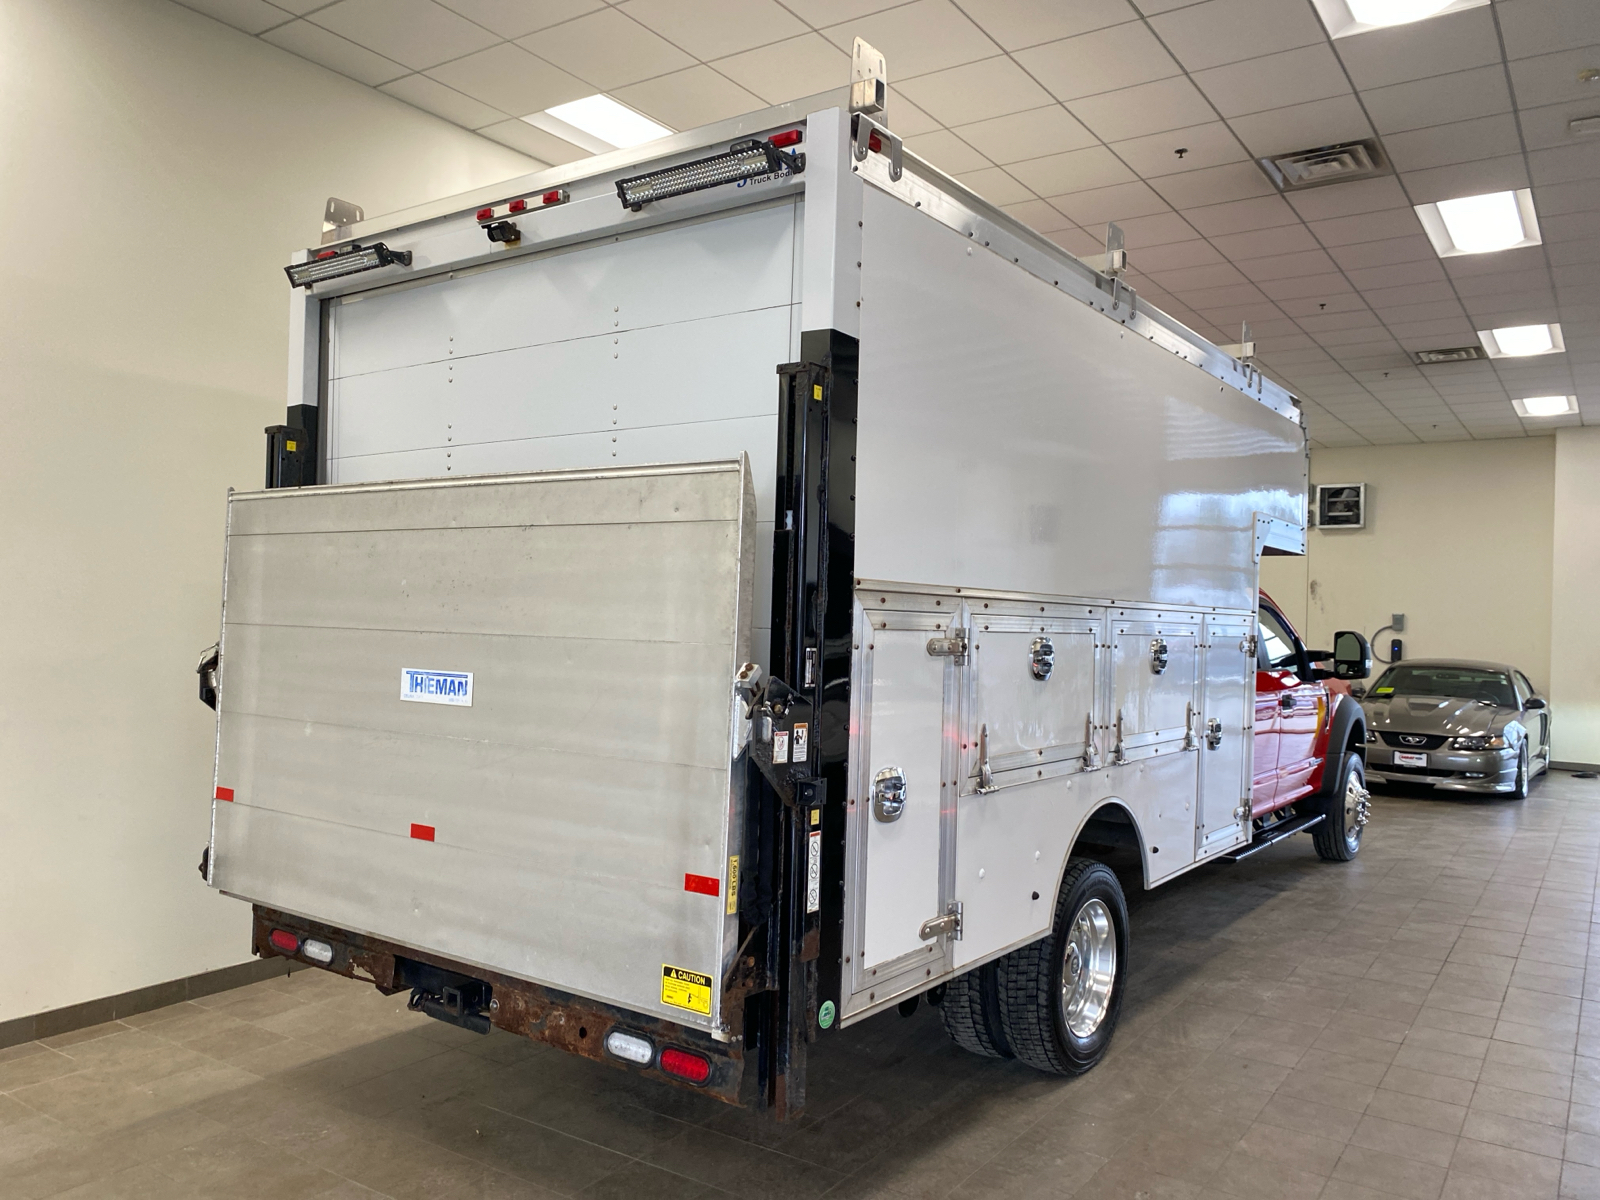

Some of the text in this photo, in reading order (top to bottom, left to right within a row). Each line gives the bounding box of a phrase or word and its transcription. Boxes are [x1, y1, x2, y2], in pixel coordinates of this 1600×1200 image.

[750, 174, 772, 186] Truck
[406, 670, 468, 697] THIEMAN
[677, 970, 706, 986] CAUTION
